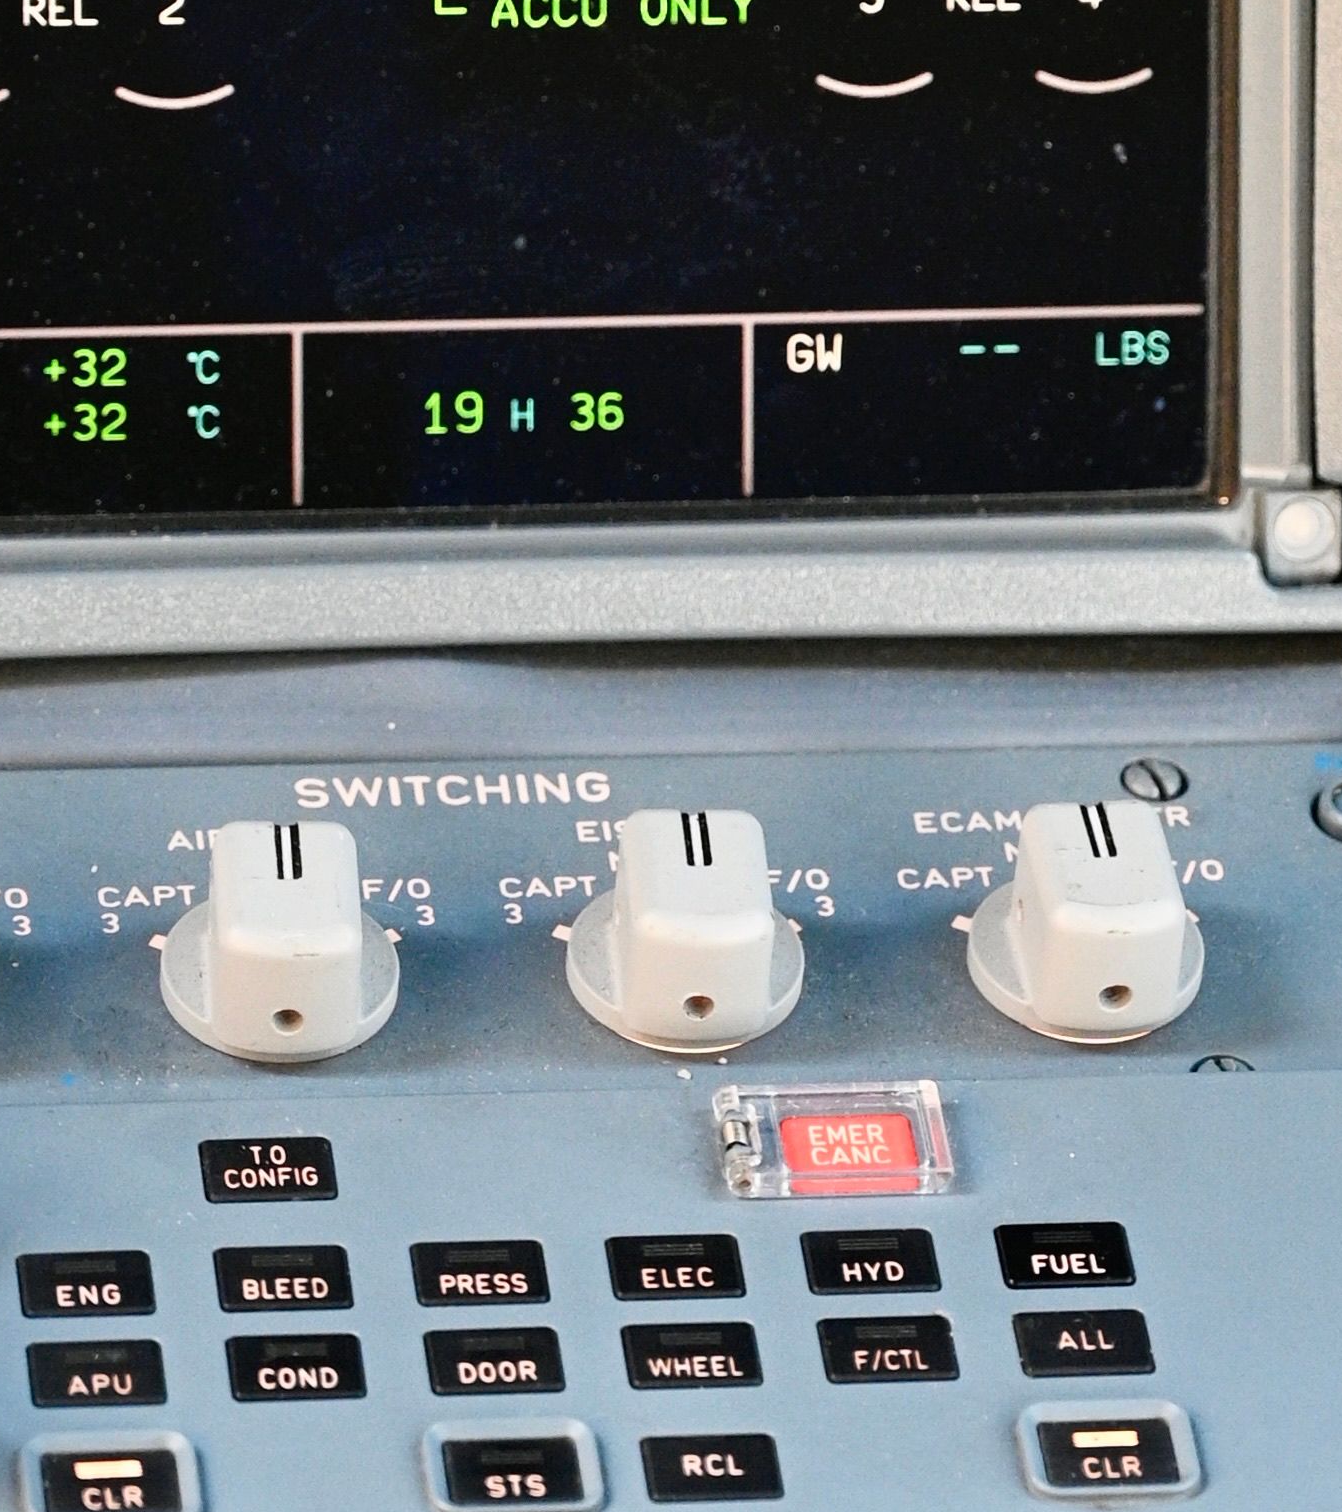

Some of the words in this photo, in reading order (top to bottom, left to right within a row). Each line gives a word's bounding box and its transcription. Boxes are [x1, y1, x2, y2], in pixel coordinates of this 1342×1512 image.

[786, 333, 843, 373] GW
[1095, 329, 1171, 367] LBS
[43, 347, 127, 388] +32
[293, 771, 611, 809] SWITCHING
[808, 1124, 885, 1146] EMER
[811, 1145, 891, 1165] CANC
[223, 1166, 319, 1189] CONFIG
[842, 1260, 904, 1282] HYD
[1030, 1253, 1107, 1275] FUEL
[242, 1277, 329, 1301] BLEED
[439, 1272, 529, 1295] PRESS
[641, 1266, 715, 1289] ELEC
[56, 1283, 121, 1307] ENG
[1058, 1329, 1114, 1351] ALL
[647, 1355, 744, 1378] WHEEL
[853, 1348, 929, 1371] F/CTL
[258, 1366, 339, 1390] COND
[457, 1360, 538, 1384] DOOR
[68, 1373, 133, 1396] APU
[681, 1453, 744, 1477] RCL
[81, 1484, 144, 1511] CLR
[484, 1474, 547, 1499] STS
